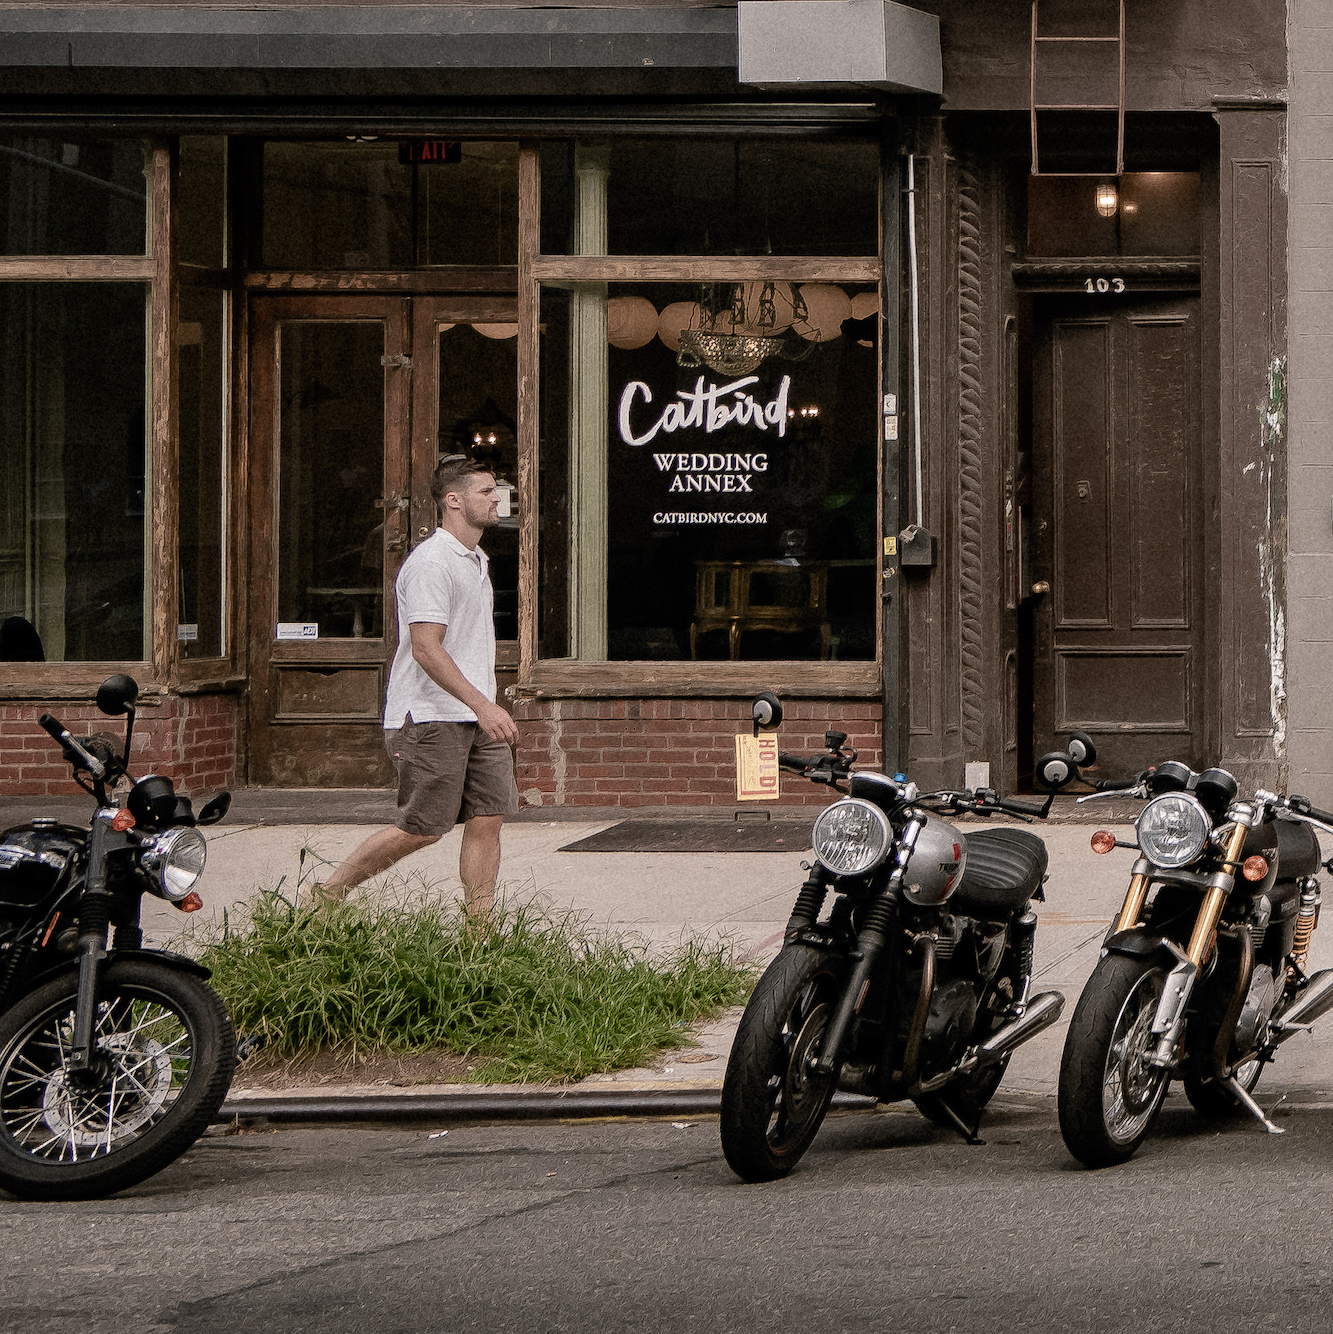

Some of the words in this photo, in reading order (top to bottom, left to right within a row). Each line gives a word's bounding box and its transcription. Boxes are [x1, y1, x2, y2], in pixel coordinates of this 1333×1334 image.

[1084, 277, 1125, 293] 103
[618, 375, 791, 447] Catbird
[653, 453, 768, 471] WEDDING
[669, 474, 753, 492] ANNEX
[653, 512, 767, 524] CATBIRDNYC.COM
[759, 739, 777, 787] HOLD
